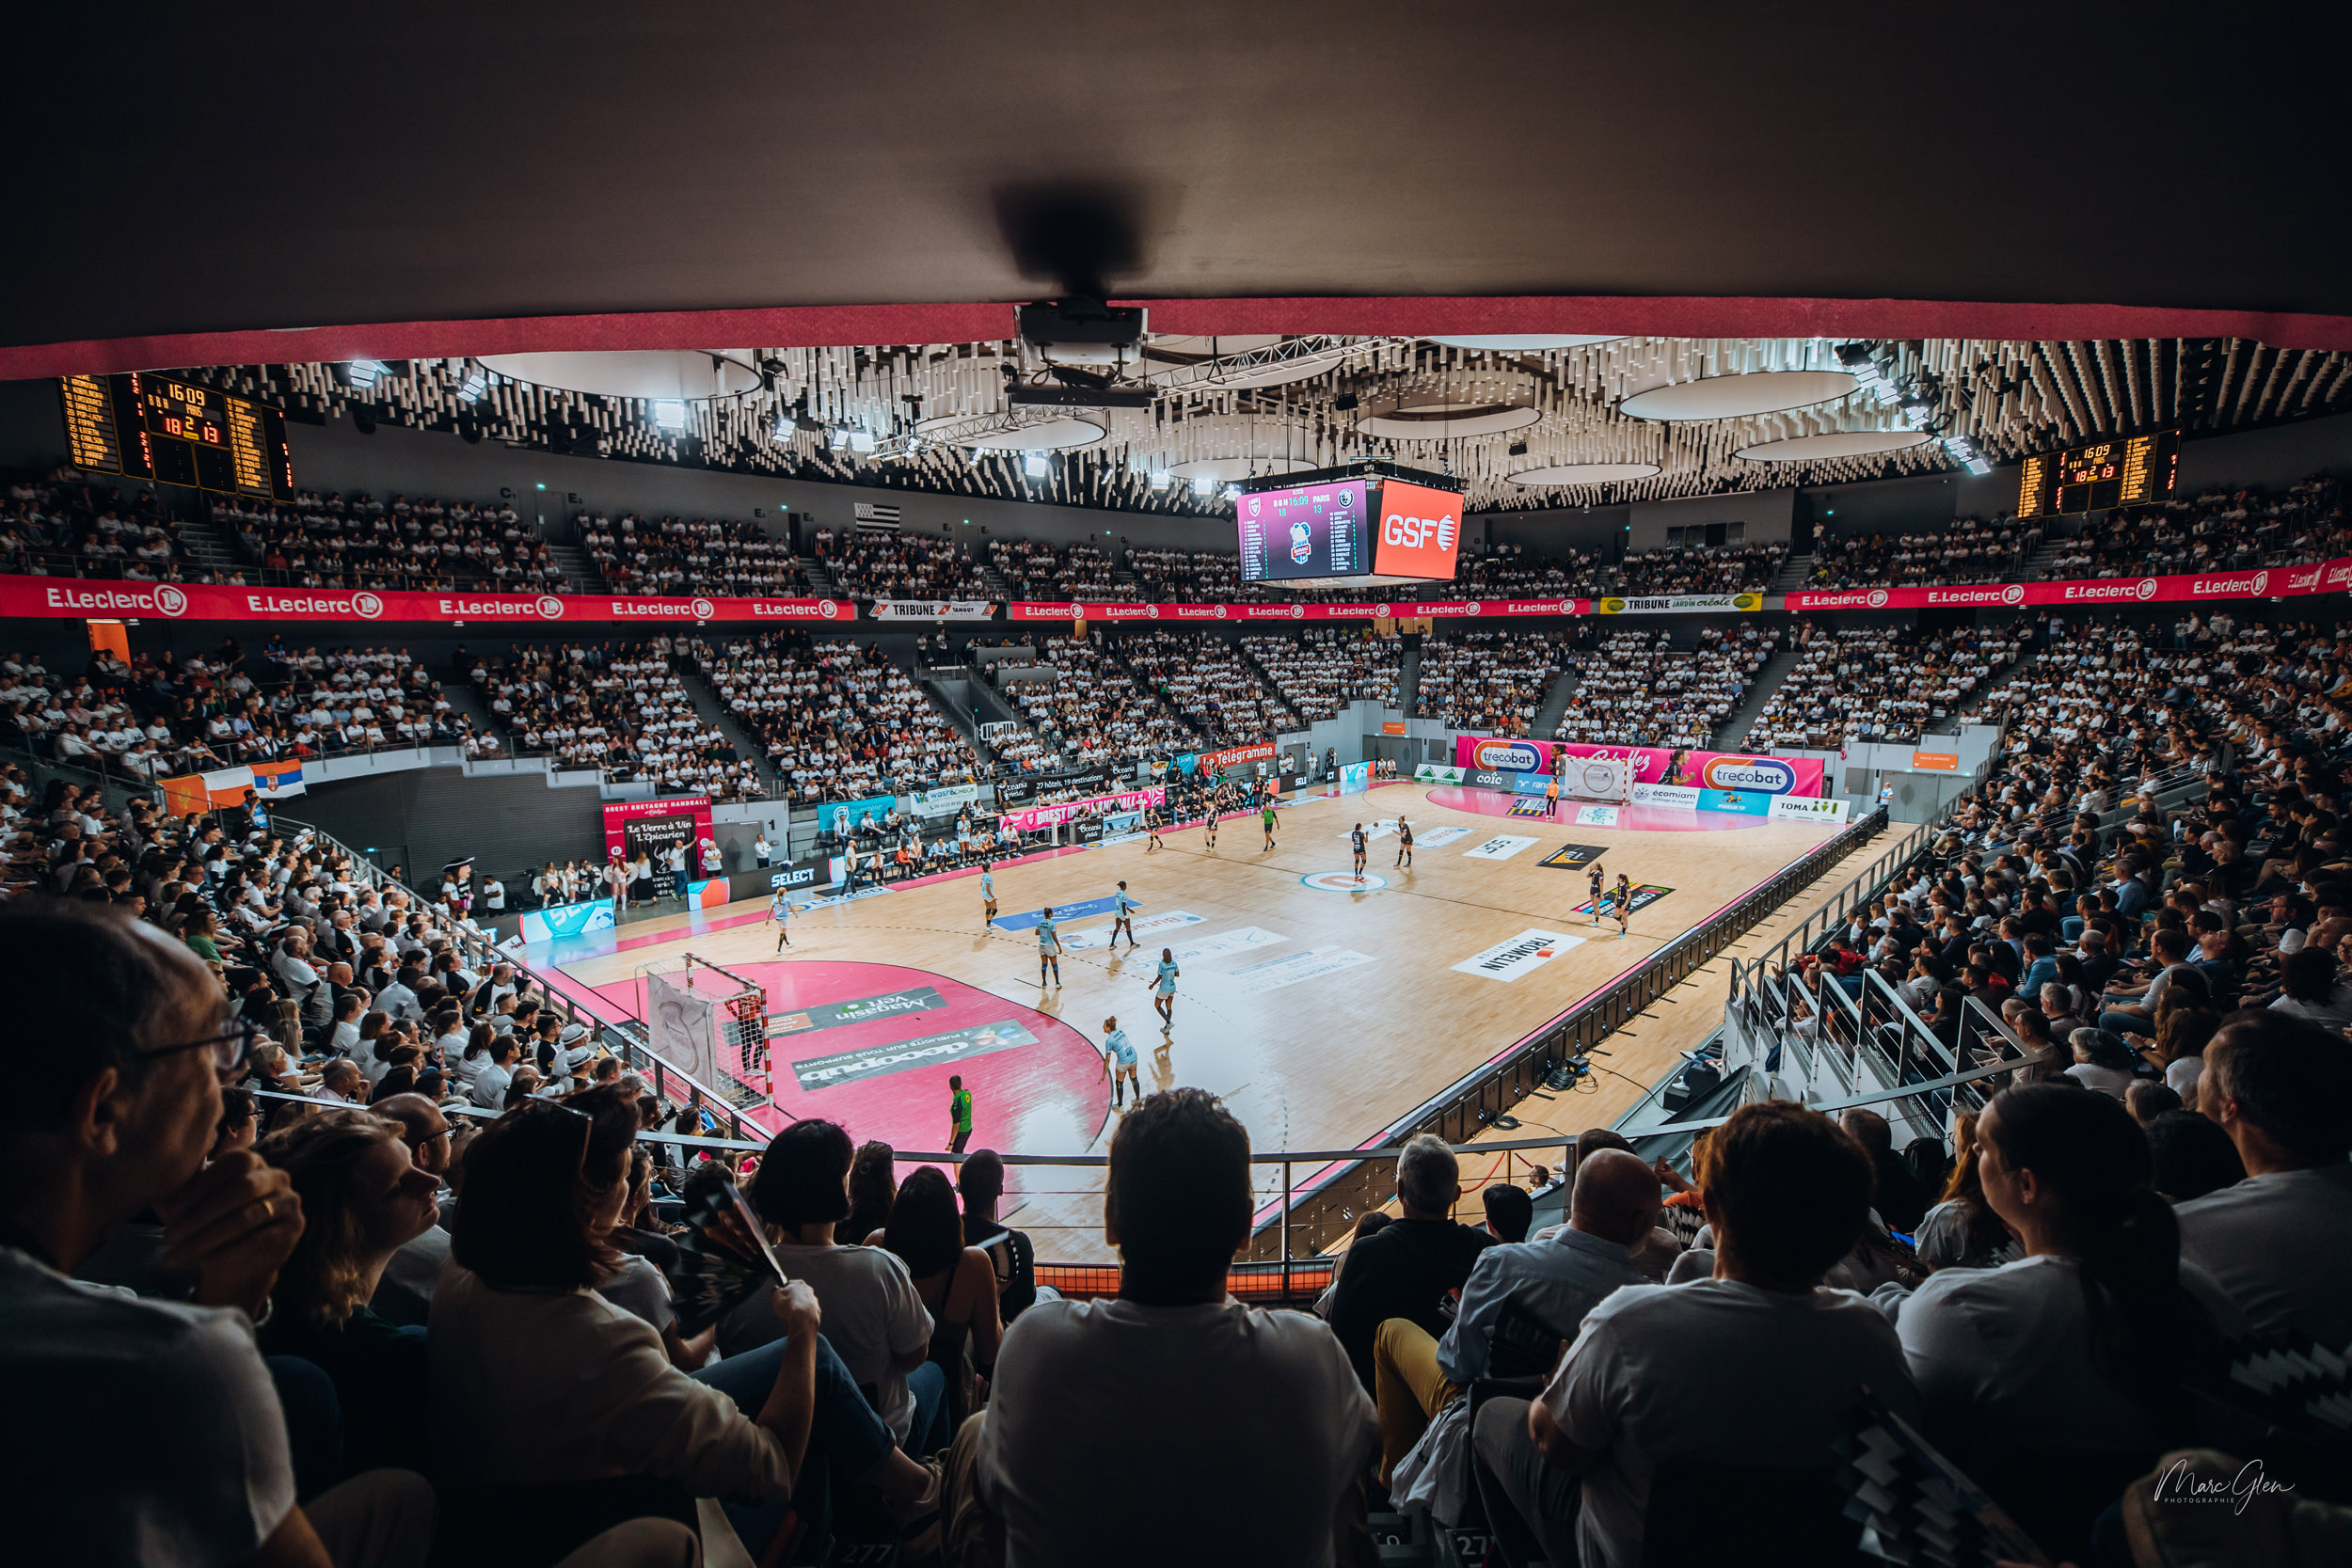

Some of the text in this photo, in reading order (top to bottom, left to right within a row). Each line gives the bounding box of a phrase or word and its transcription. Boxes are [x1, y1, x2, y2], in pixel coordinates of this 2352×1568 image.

[68, 416, 76, 424] 22
[166, 418, 182, 436] 18
[185, 416, 194, 431] 2
[203, 426, 218, 443] 13
[2075, 466, 2114, 483] 18 2 13
[1289, 495, 1309, 507] 16:09
[1312, 494, 1330, 503] PARIS
[1279, 504, 1322, 517] 18 13
[1384, 515, 1438, 549] GSF
[2065, 586, 2136, 599] E.Leclerc
[2193, 578, 2250, 594] E.Leclerc
[47, 588, 152, 610] E.Leclerc
[247, 595, 350, 613] E.Leclerc
[1629, 599, 1671, 610] TRIBUNE
[1672, 598, 1695, 608] JARDIN
[1696, 596, 1731, 608] créole
[1802, 594, 1866, 607] E.Leclerc
[1928, 592, 2000, 603] E.Leclerc
[439, 599, 534, 614] E.Leclerc
[612, 602, 690, 615] E.Leclerc
[754, 603, 818, 615] E.Leclerc
[893, 604, 935, 616] TRIBUNE
[1025, 606, 1071, 616] E.Leclerc
[1106, 607, 1147, 617] E.Leclerc
[1178, 607, 1215, 617] E.Leclerc
[1248, 607, 1290, 617] E.Leclerc
[1328, 607, 1375, 616] E.Leclerc
[1417, 605, 1464, 614] E.Leclerc
[1508, 603, 1558, 613] E.Leclerc
[1306, 741, 1311, 750] 2
[1216, 746, 1273, 765] Télégramme
[1484, 752, 1532, 765] trecobat
[1112, 765, 1136, 775] Oceania
[1716, 768, 1782, 785] trecobat
[1071, 774, 1104, 784] destinations
[1004, 781, 1027, 791] ceania
[1652, 789, 1696, 800] écomiam
[630, 801, 669, 811] BRETAGNE
[670, 799, 707, 807] HANDBALL
[1780, 802, 1808, 812] TOMA
[1036, 807, 1067, 825] BREST
[628, 825, 640, 833] Le
[641, 822, 667, 832] Verre
[668, 821, 675, 830] à
[675, 820, 692, 829] Vin
[768, 819, 775, 831] 1
[1080, 823, 1103, 833] Oceania
[771, 867, 815, 889] SELECT
[1480, 937, 1556, 971] TROMELIN
[834, 998, 925, 1022] Magasin
[795, 1033, 961, 1070] PUBLICITE SUR TOUS SUPPORTS
[799, 1041, 970, 1082] decopub
